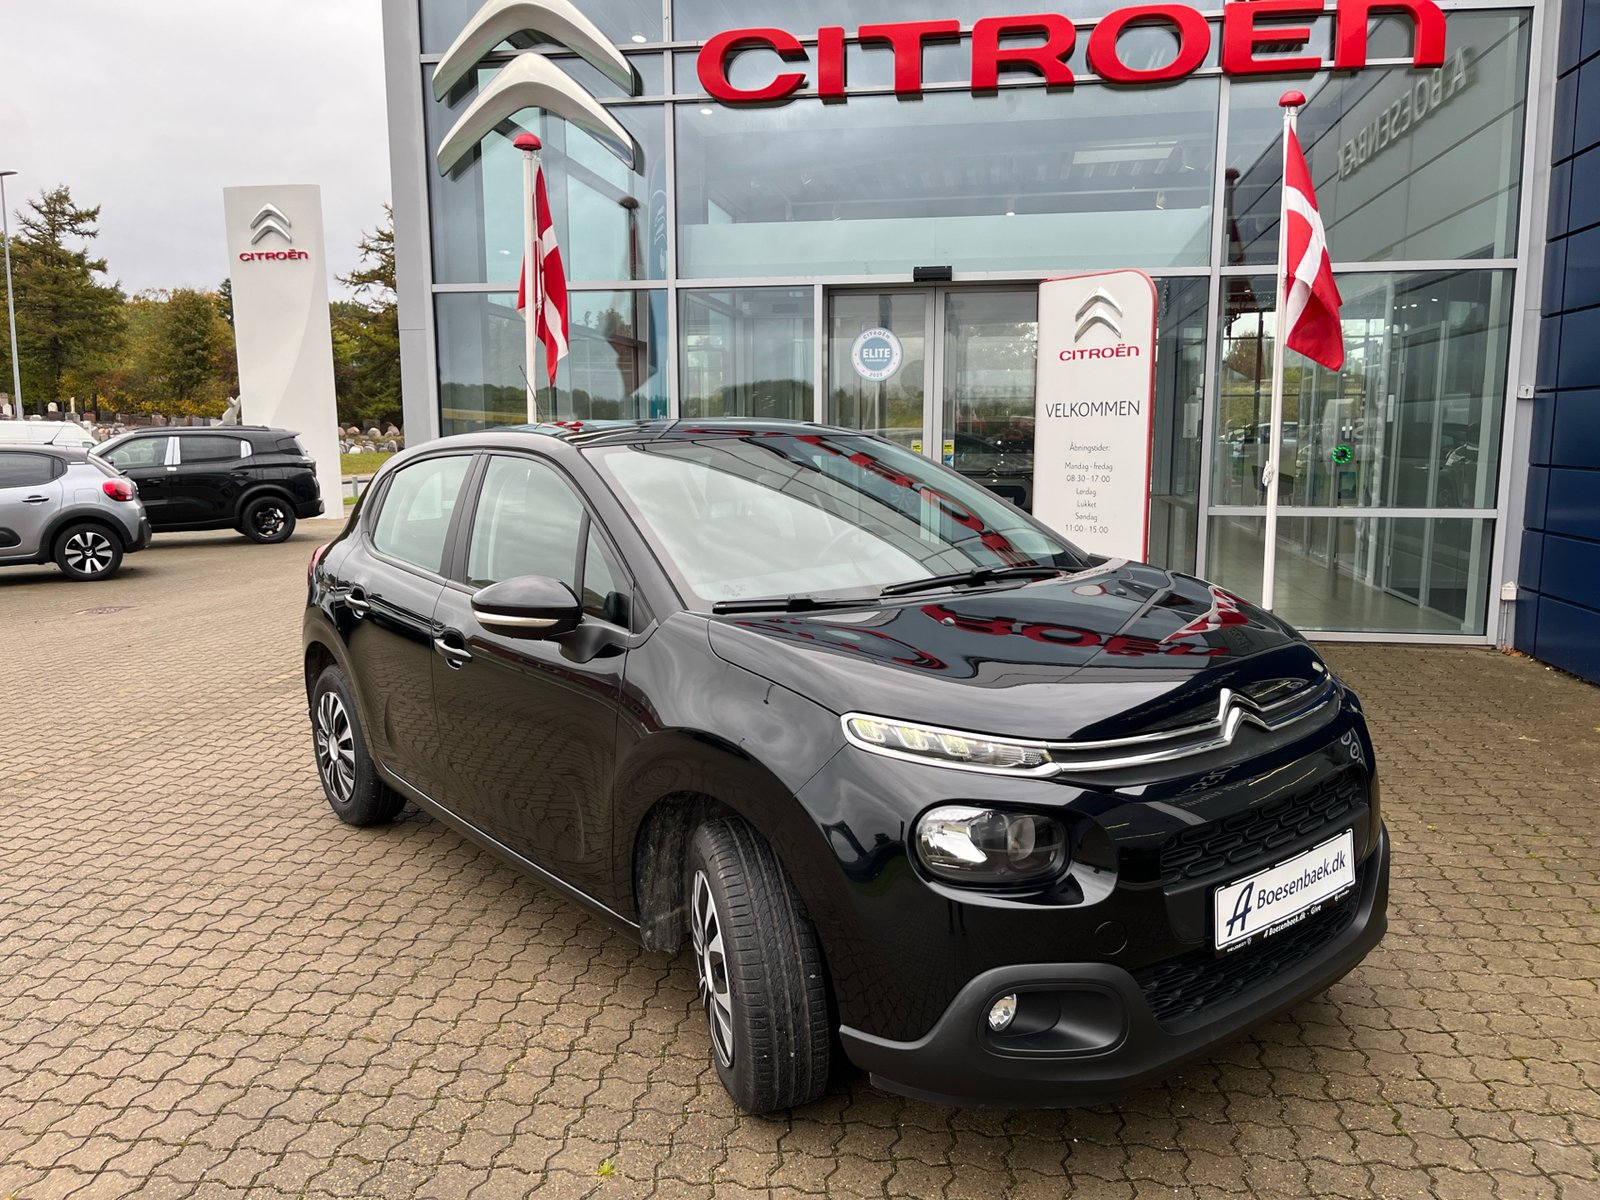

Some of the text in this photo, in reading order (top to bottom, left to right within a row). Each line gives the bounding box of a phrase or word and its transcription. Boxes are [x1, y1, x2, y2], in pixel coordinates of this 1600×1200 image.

[239, 249, 309, 261] CITROËN
[862, 348, 891, 358] ELITE
[1059, 343, 1140, 361] CITROËN
[1045, 400, 1140, 418] VELKOMMEN
[1065, 462, 1089, 472] Mandag
[1094, 462, 1113, 472] fredag
[1076, 488, 1097, 497] Lørdag
[1077, 500, 1097, 508] Lukket
[1075, 512, 1098, 522] Søndag
[1226, 850, 1346, 938] A Boesenbaek.dk
